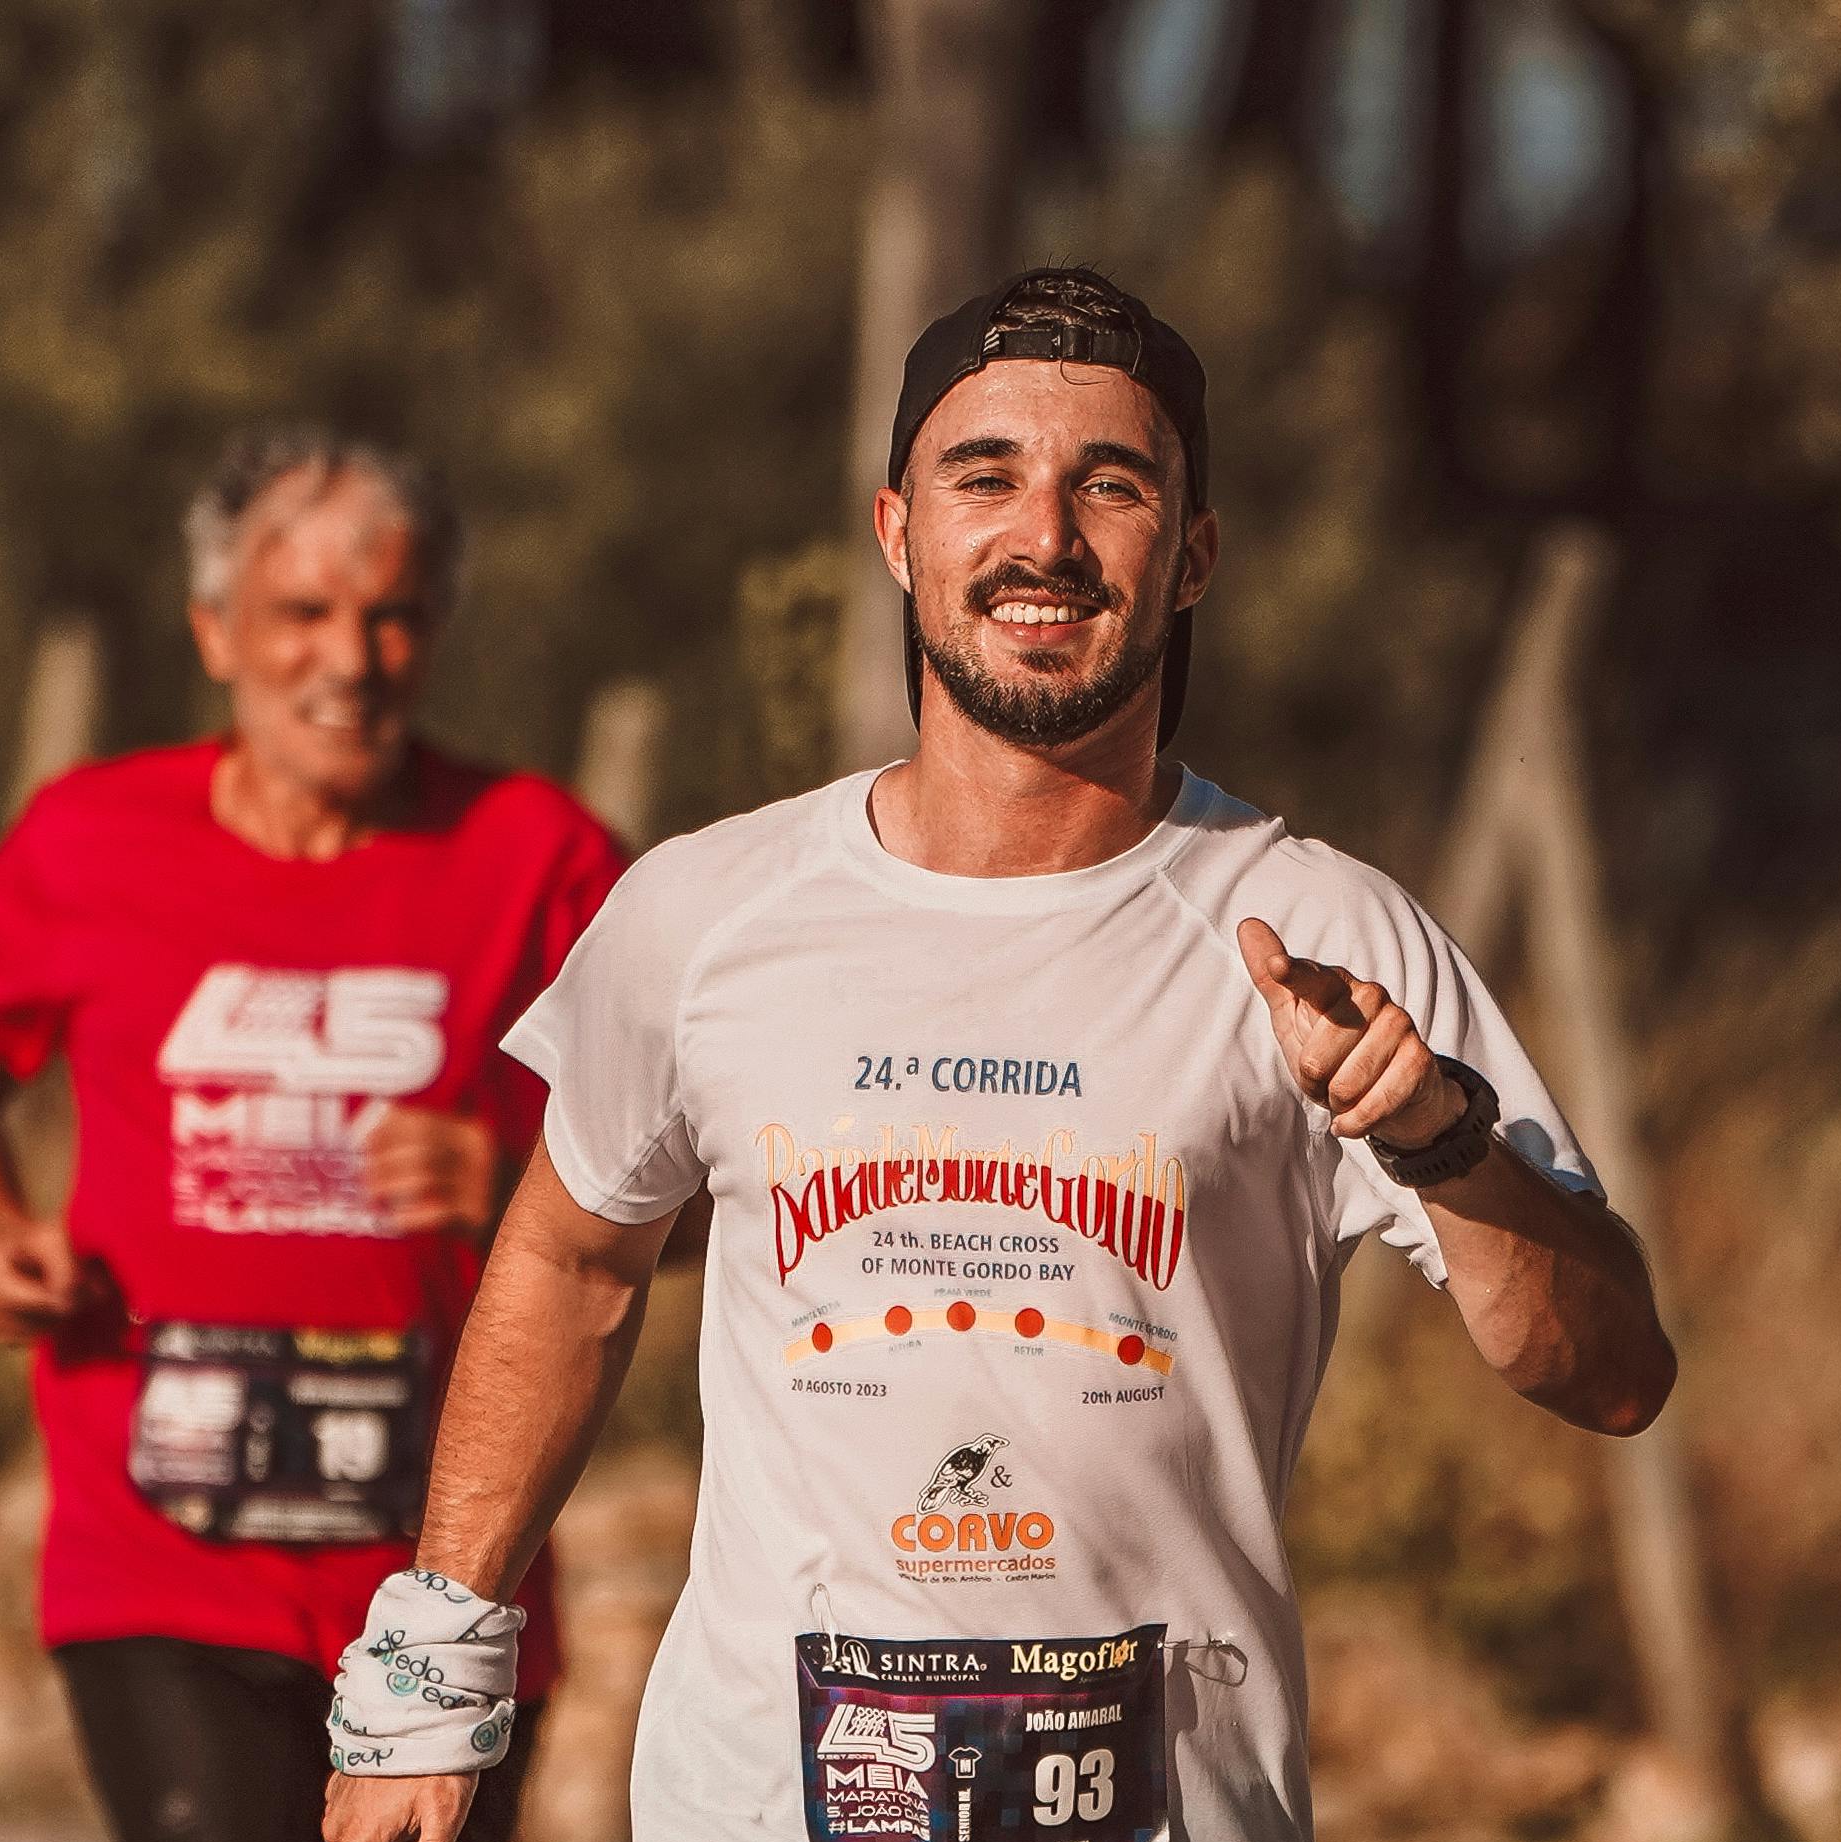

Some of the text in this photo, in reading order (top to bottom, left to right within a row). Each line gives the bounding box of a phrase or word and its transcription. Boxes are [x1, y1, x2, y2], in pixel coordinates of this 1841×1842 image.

[932, 1057, 1082, 1097] CORRIDA
[872, 1231, 1059, 1253] 24 th. BEACH CROSS
[861, 1257, 1075, 1281] OF MONTE GORDO BAY
[791, 1378, 887, 1397] 20 AGOSTO 2023
[1082, 1386, 1164, 1404] 20th AUGUST
[990, 1465, 1013, 1488] &
[891, 1512, 1055, 1552] CORVO
[895, 1554, 1056, 1577] supermercados
[880, 1654, 980, 1673] SINTRA
[1010, 1639, 1138, 1681] Magoflor
[1025, 1704, 1122, 1733] JOÃO AMARAL
[826, 1763, 928, 1800] MEIA
[1033, 1748, 1114, 1826] 93
[826, 1791, 929, 1814] MARATONA
[826, 1803, 929, 1827] S. JOÃO DAS
[958, 1803, 971, 1842] SENIOR
[828, 1819, 931, 1842] #LAMPAS
